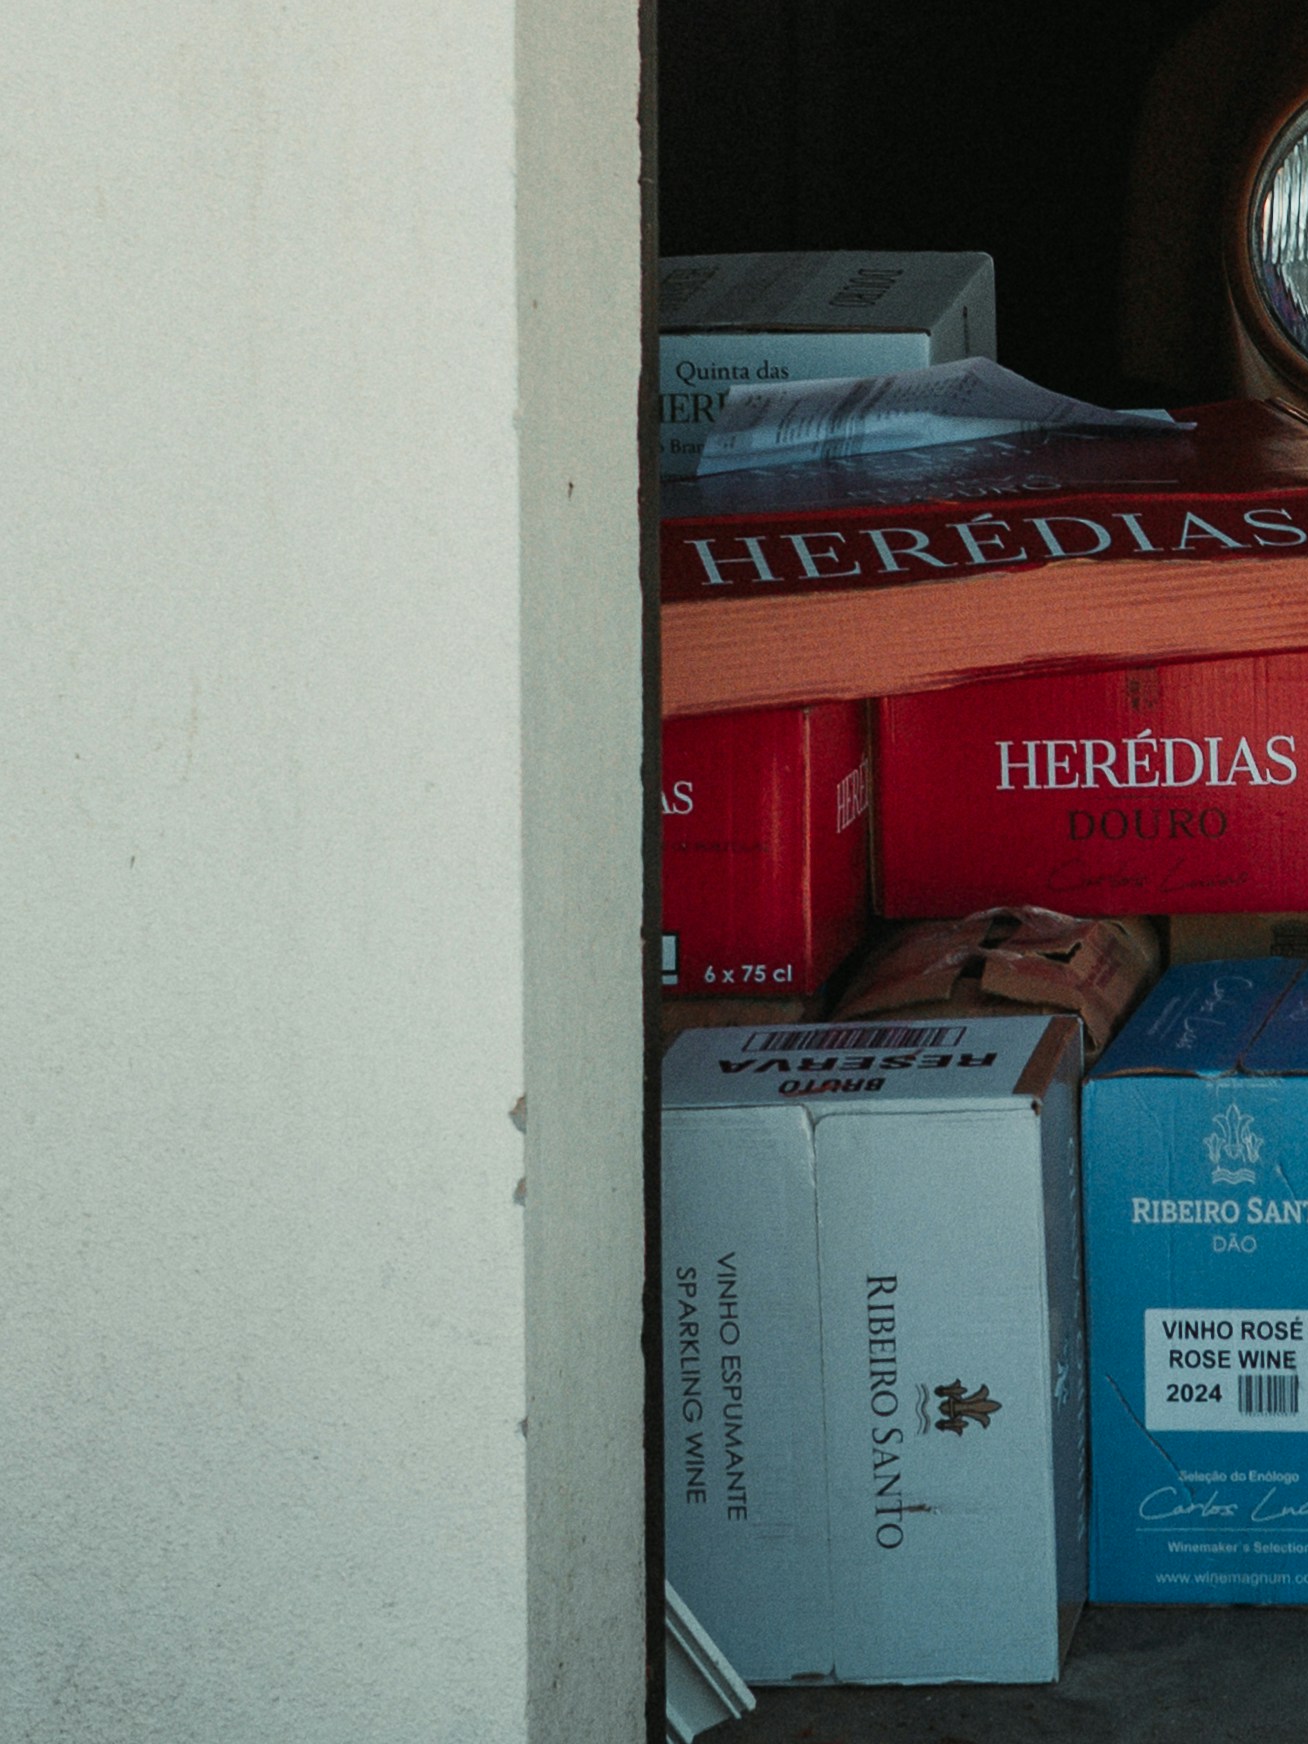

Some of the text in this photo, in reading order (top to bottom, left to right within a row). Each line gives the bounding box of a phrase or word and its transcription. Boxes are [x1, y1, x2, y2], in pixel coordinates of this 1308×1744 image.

[675, 359, 790, 388] Quinta das
[684, 508, 1307, 586] HERÉDIAS
[995, 729, 1298, 790] HERÉDIAS
[1067, 808, 1229, 841] DOURO
[704, 964, 792, 984] 6 x 75 cl
[718, 1053, 998, 1074] RESERVA
[778, 1077, 886, 1095] BRUTO
[1131, 1197, 1240, 1225] RIBEIRO
[1212, 1233, 1258, 1253] DÃO
[1162, 1315, 1304, 1341] VINHO ROSÉ
[1168, 1349, 1298, 1369] ROSE WINE
[676, 1266, 707, 1504] SPARKLING WINE
[717, 1252, 747, 1521] VINHO ESPUMANTE
[1166, 1383, 1223, 1403] 2024
[866, 1274, 904, 1550] RIBEIRO SANTO
[1248, 1469, 1300, 1485] Enólogo
[1138, 1486, 1239, 1521] Carlos
